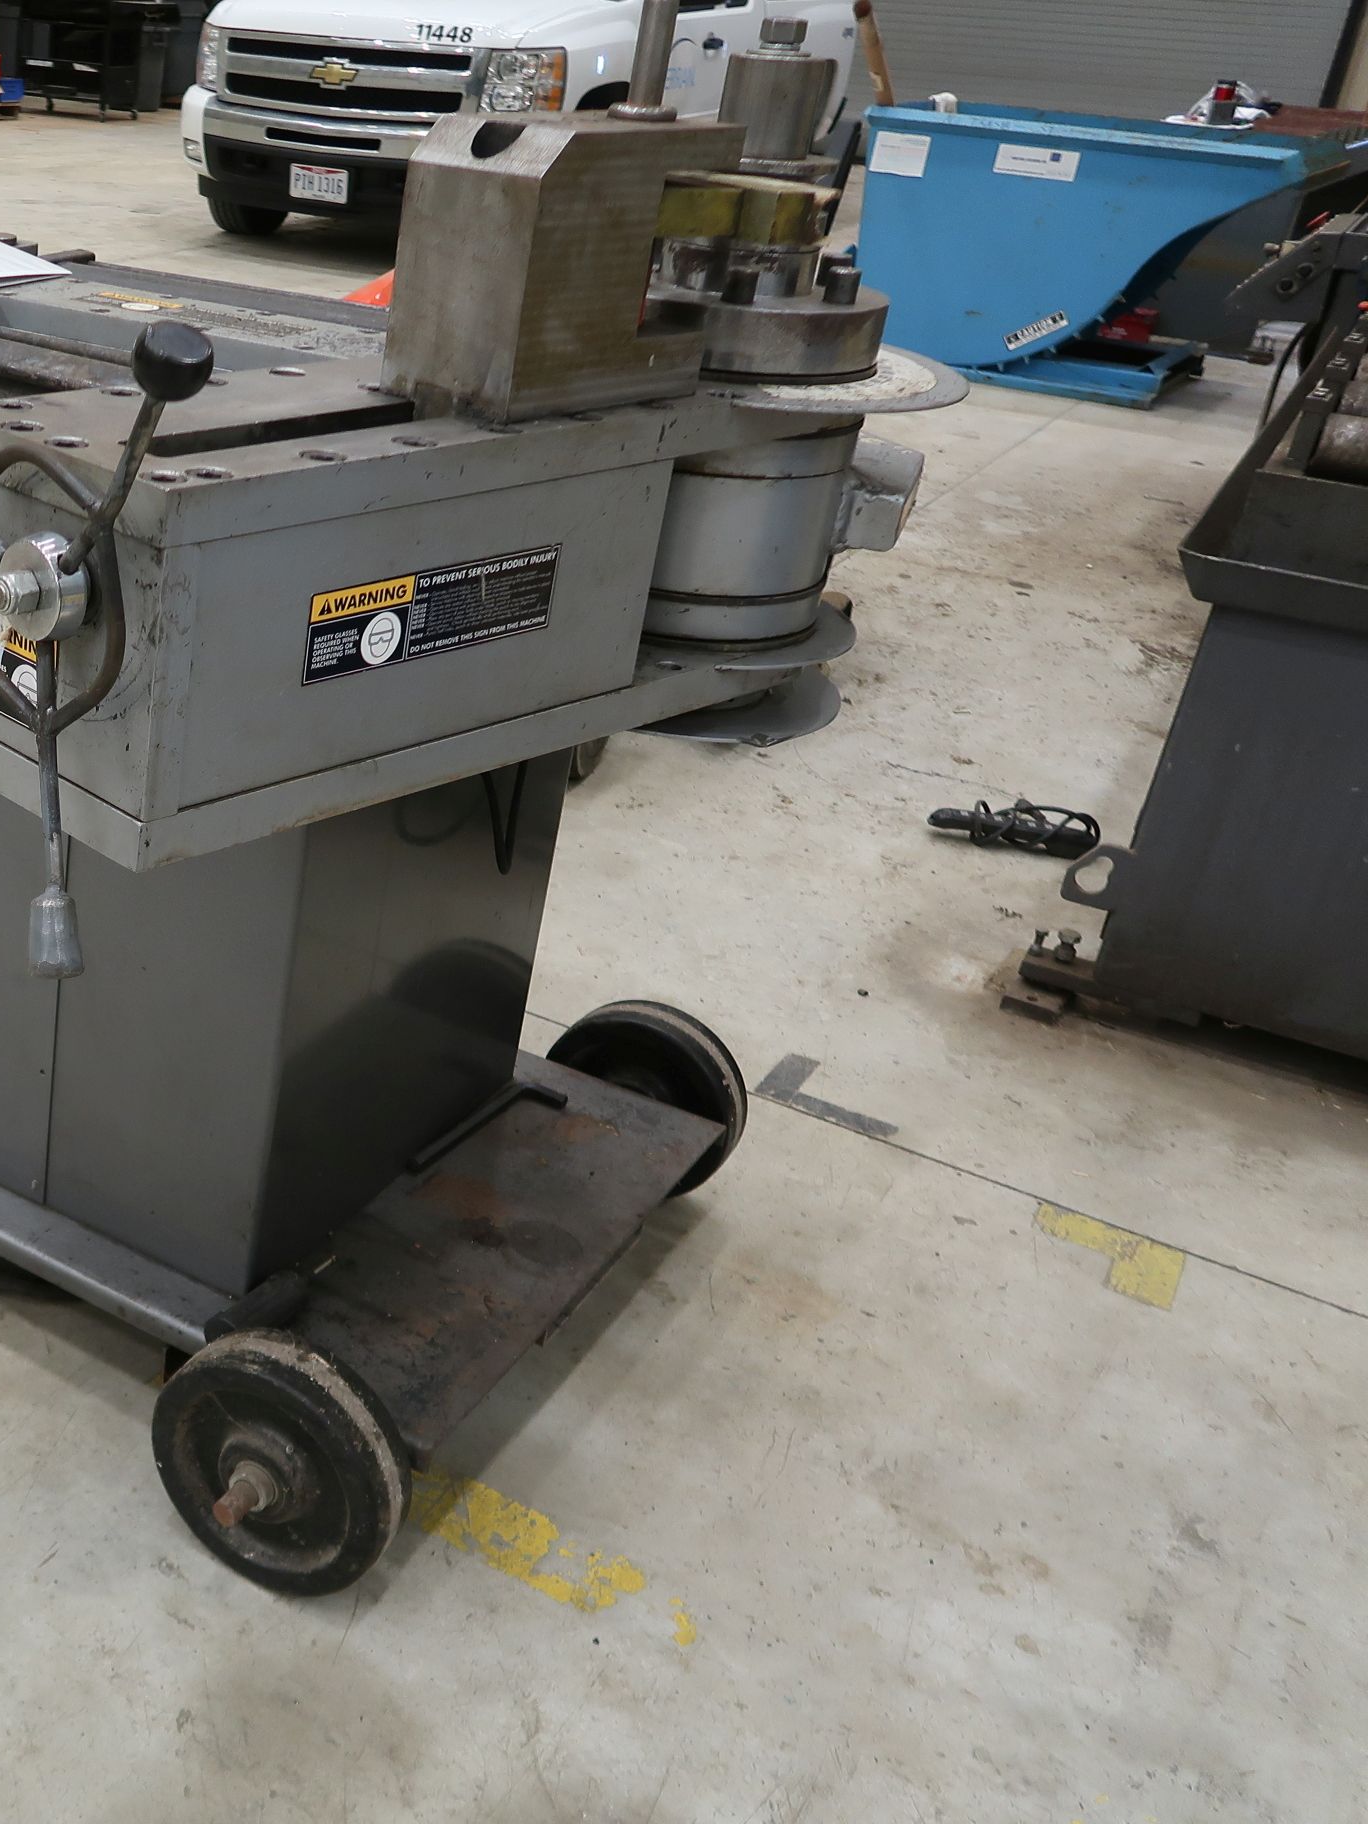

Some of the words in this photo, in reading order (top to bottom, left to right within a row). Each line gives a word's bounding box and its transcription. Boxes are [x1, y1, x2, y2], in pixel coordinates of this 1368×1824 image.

[416, 24, 473, 43] 11448
[419, 577, 431, 588] TO
[432, 569, 467, 586] PREVENT
[501, 556, 530, 570] BODILY
[530, 550, 558, 564] INJURY
[334, 584, 408, 613] WARNING
[421, 642, 434, 651] NOT
[435, 635, 460, 646] REMOVE
[460, 632, 474, 641] THIS
[474, 628, 489, 638] SIGN
[489, 624, 506, 635] FROM
[506, 621, 519, 630] THIS
[519, 615, 547, 628] MACHINE
